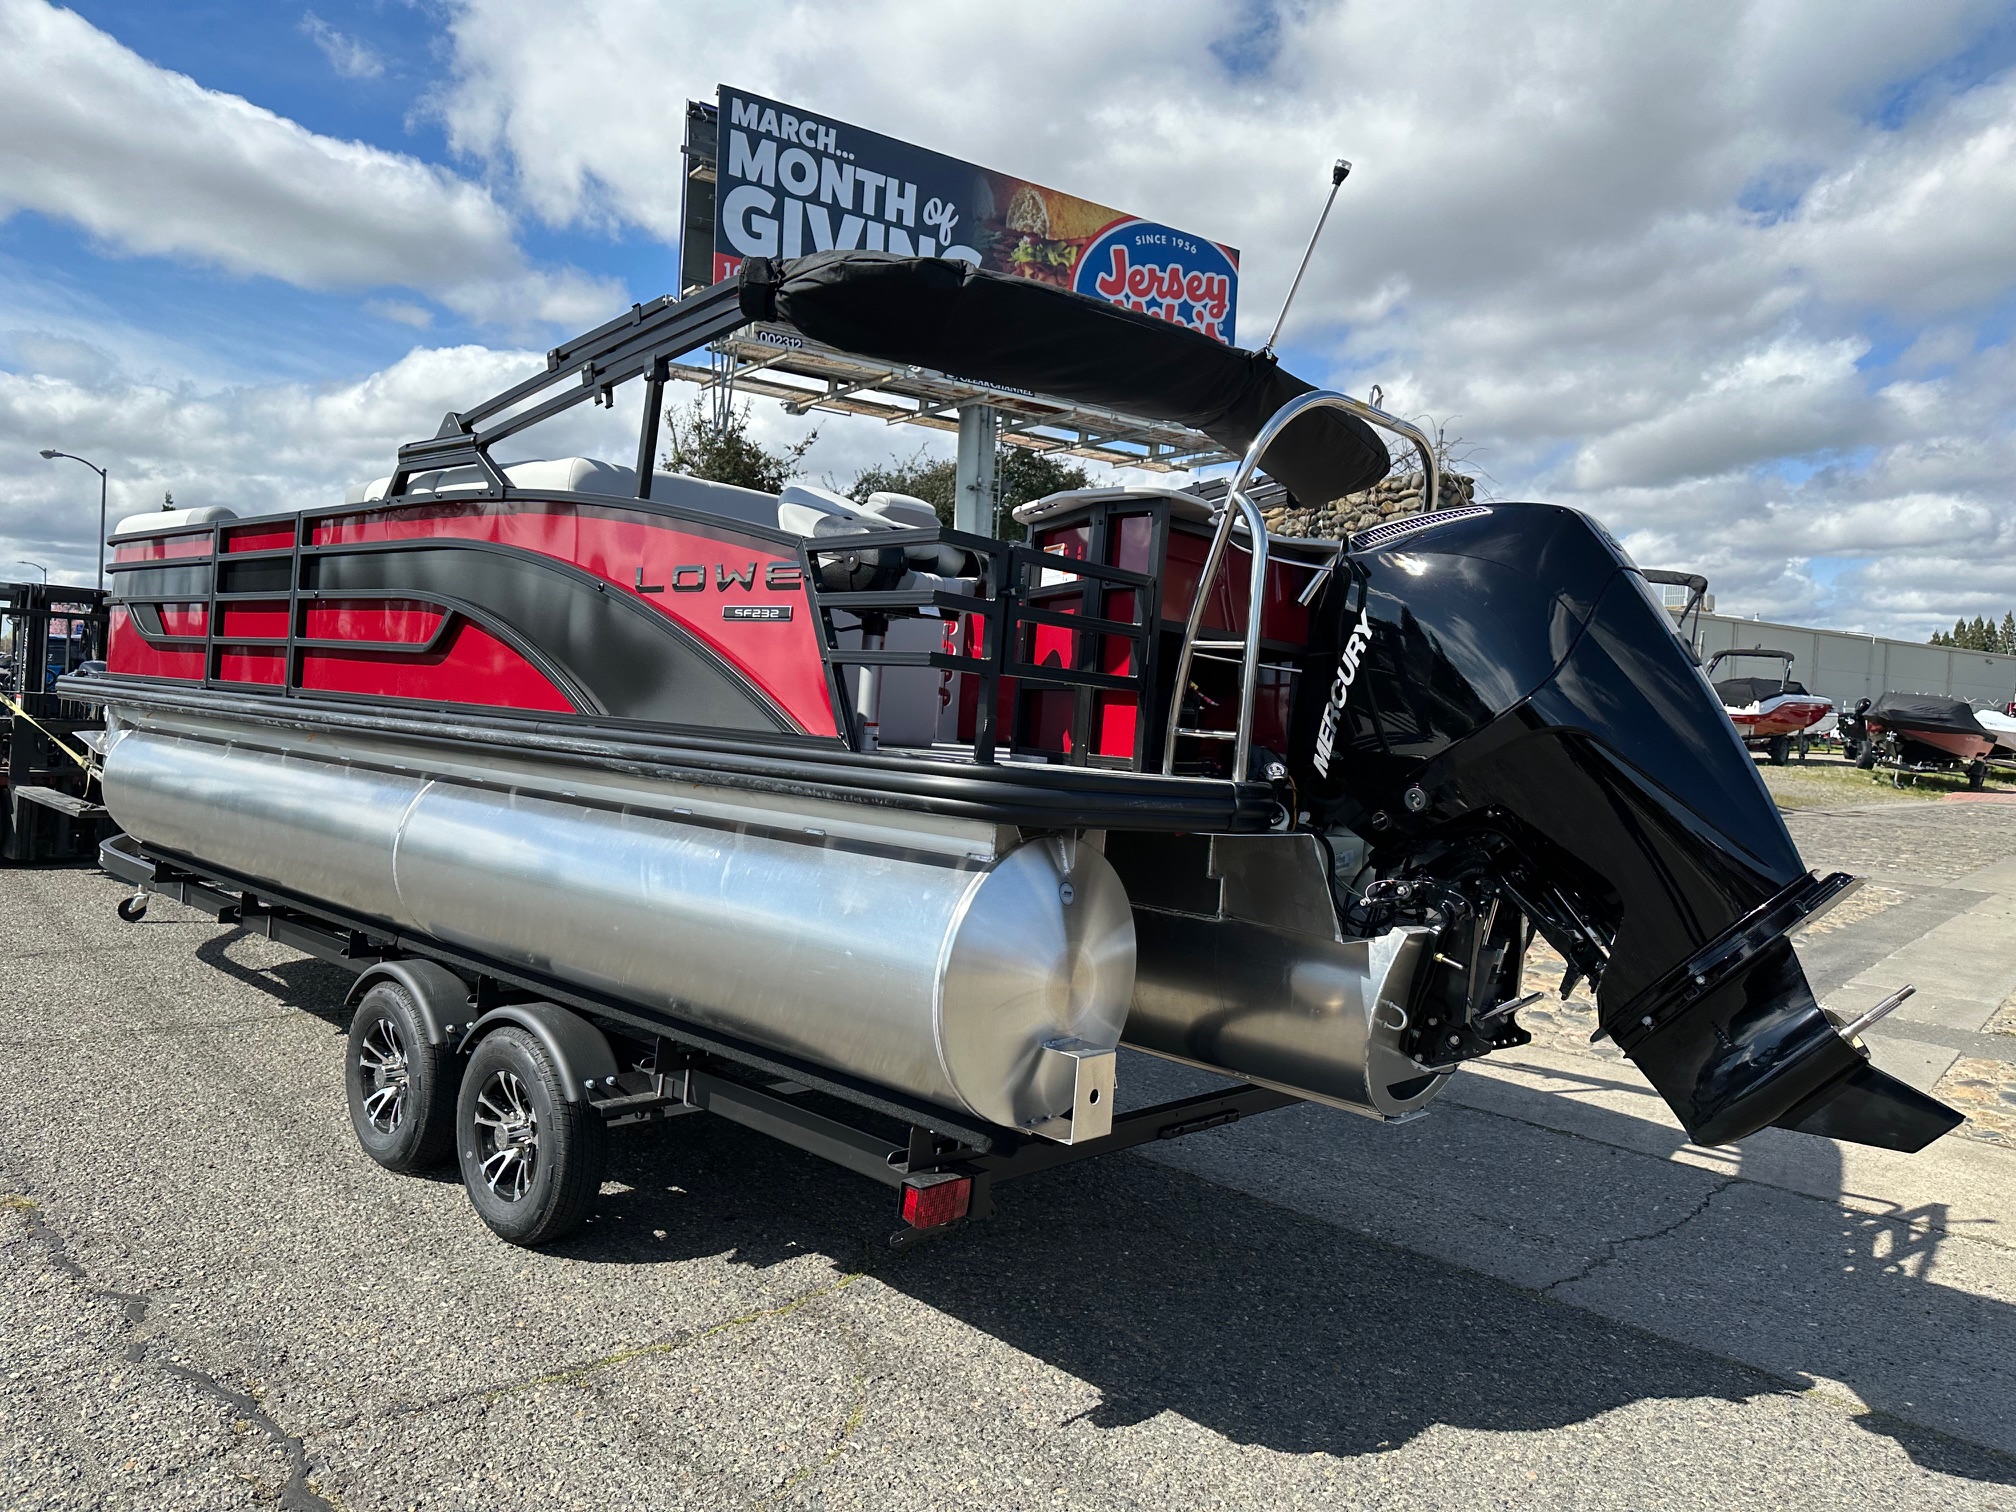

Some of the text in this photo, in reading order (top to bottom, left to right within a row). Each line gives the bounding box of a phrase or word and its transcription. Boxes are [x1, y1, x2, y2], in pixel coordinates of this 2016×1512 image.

[730, 97, 855, 160] MARCH...
[728, 129, 959, 247] MONTH of
[1135, 234, 1197, 254] SINCE 1956
[1097, 247, 1228, 320] Jersey
[759, 331, 802, 349] 002312
[635, 561, 802, 593] LOWE
[734, 609, 779, 618] SF232
[1313, 607, 1373, 779] MERCURY
